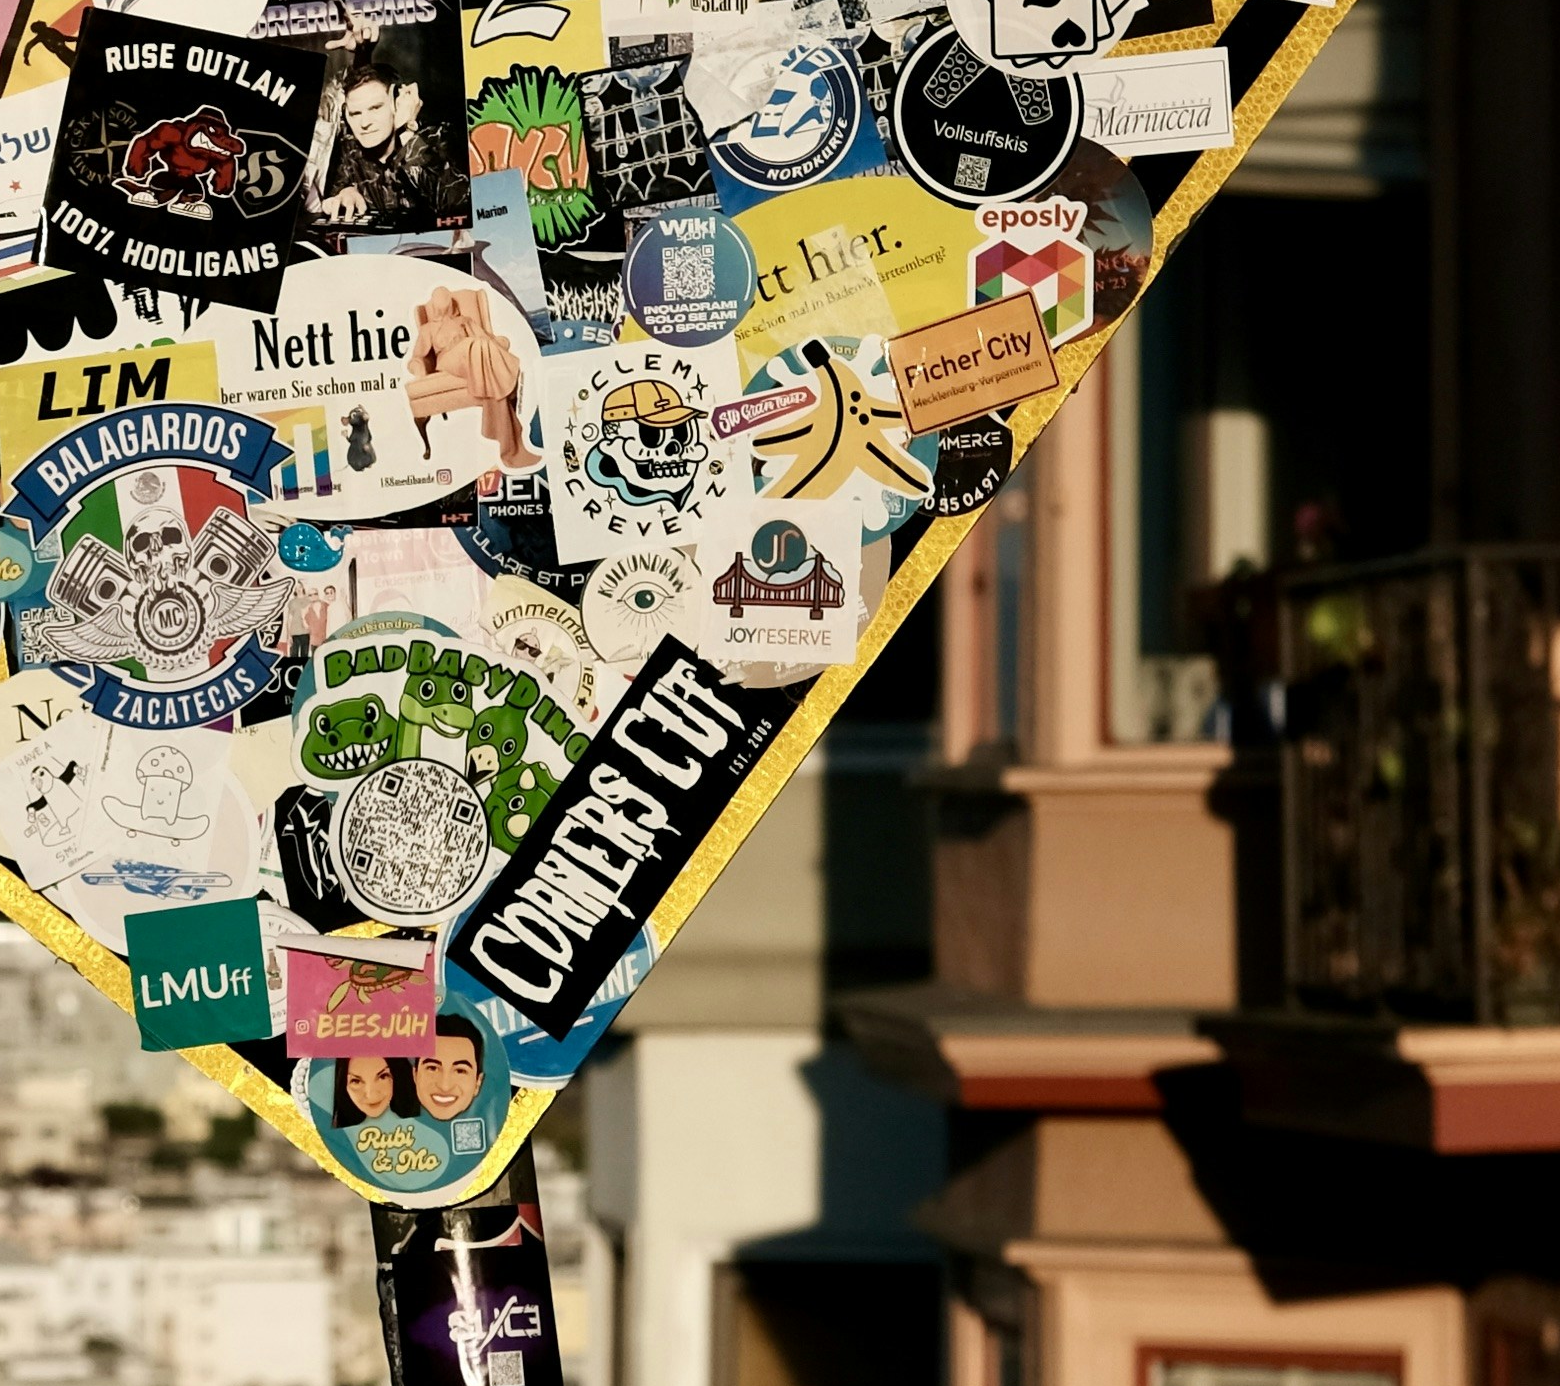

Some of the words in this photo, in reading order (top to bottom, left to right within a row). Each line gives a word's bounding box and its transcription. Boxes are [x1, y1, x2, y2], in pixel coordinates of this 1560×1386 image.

[105, 43, 176, 74] RUSE
[186, 45, 296, 108] OUTLAW
[765, 116, 850, 180] NORDKURVE
[933, 119, 1029, 154] Vollsuffskis
[476, 205, 508, 220] Marion
[982, 204, 1080, 233] eposly
[50, 199, 115, 256] 100%
[122, 241, 280, 279] HOOLIGANS
[643, 300, 738, 315] INQUADRAMI
[644, 313, 685, 324] SOLO
[710, 310, 737, 321] AMI
[653, 323, 673, 334] LO
[675, 321, 727, 333] SPORT
[252, 317, 334, 372] Nett
[987, 330, 1033, 361] City
[37, 357, 172, 421] LIM
[246, 387, 287, 402] waren
[291, 381, 312, 399] Sie
[316, 381, 356, 395] schon
[360, 374, 385, 391] mal
[37, 412, 248, 498] BALAGARDOS
[488, 504, 543, 517] PHONES
[158, 609, 183, 629] MC
[110, 667, 256, 726] ZACATECAS
[748, 717, 774, 749] 2005
[140, 964, 253, 1009] LMUff
[357, 1125, 415, 1152] Rubi
[396, 1147, 442, 1174] Mo
